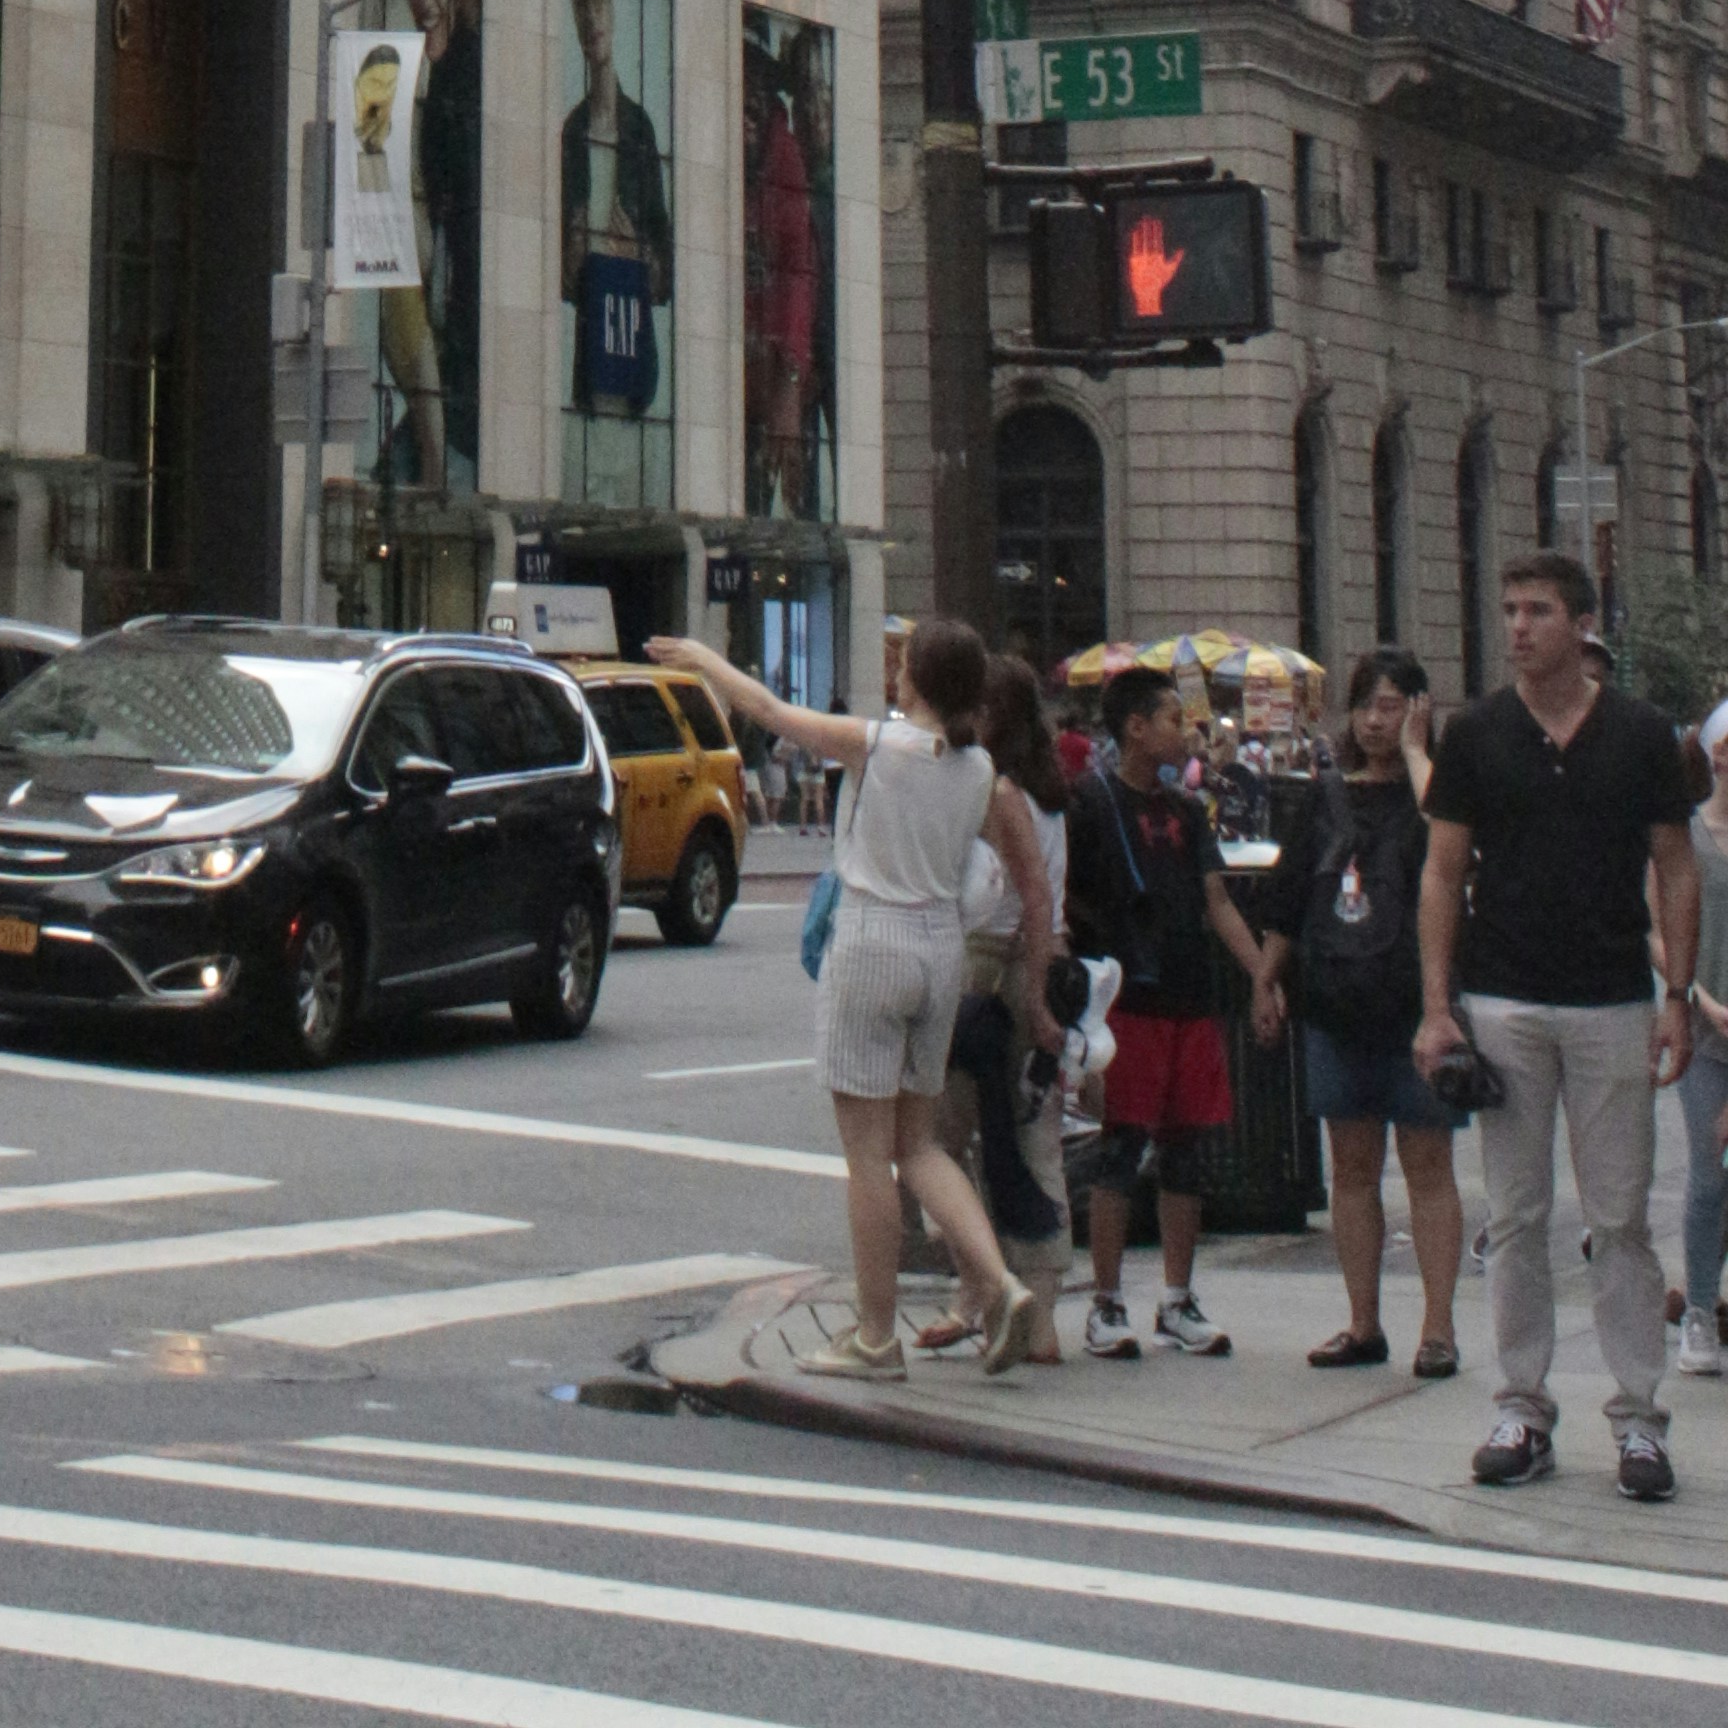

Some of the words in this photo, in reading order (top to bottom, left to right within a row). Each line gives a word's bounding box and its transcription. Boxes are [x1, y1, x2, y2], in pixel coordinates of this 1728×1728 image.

[1042, 51, 1062, 110] E
[1087, 46, 1135, 108] 53
[1156, 44, 1185, 82] St
[355, 258, 399, 275] MoMA
[604, 293, 641, 357] GAP
[525, 552, 551, 573] GAP
[713, 568, 741, 591] GAP
